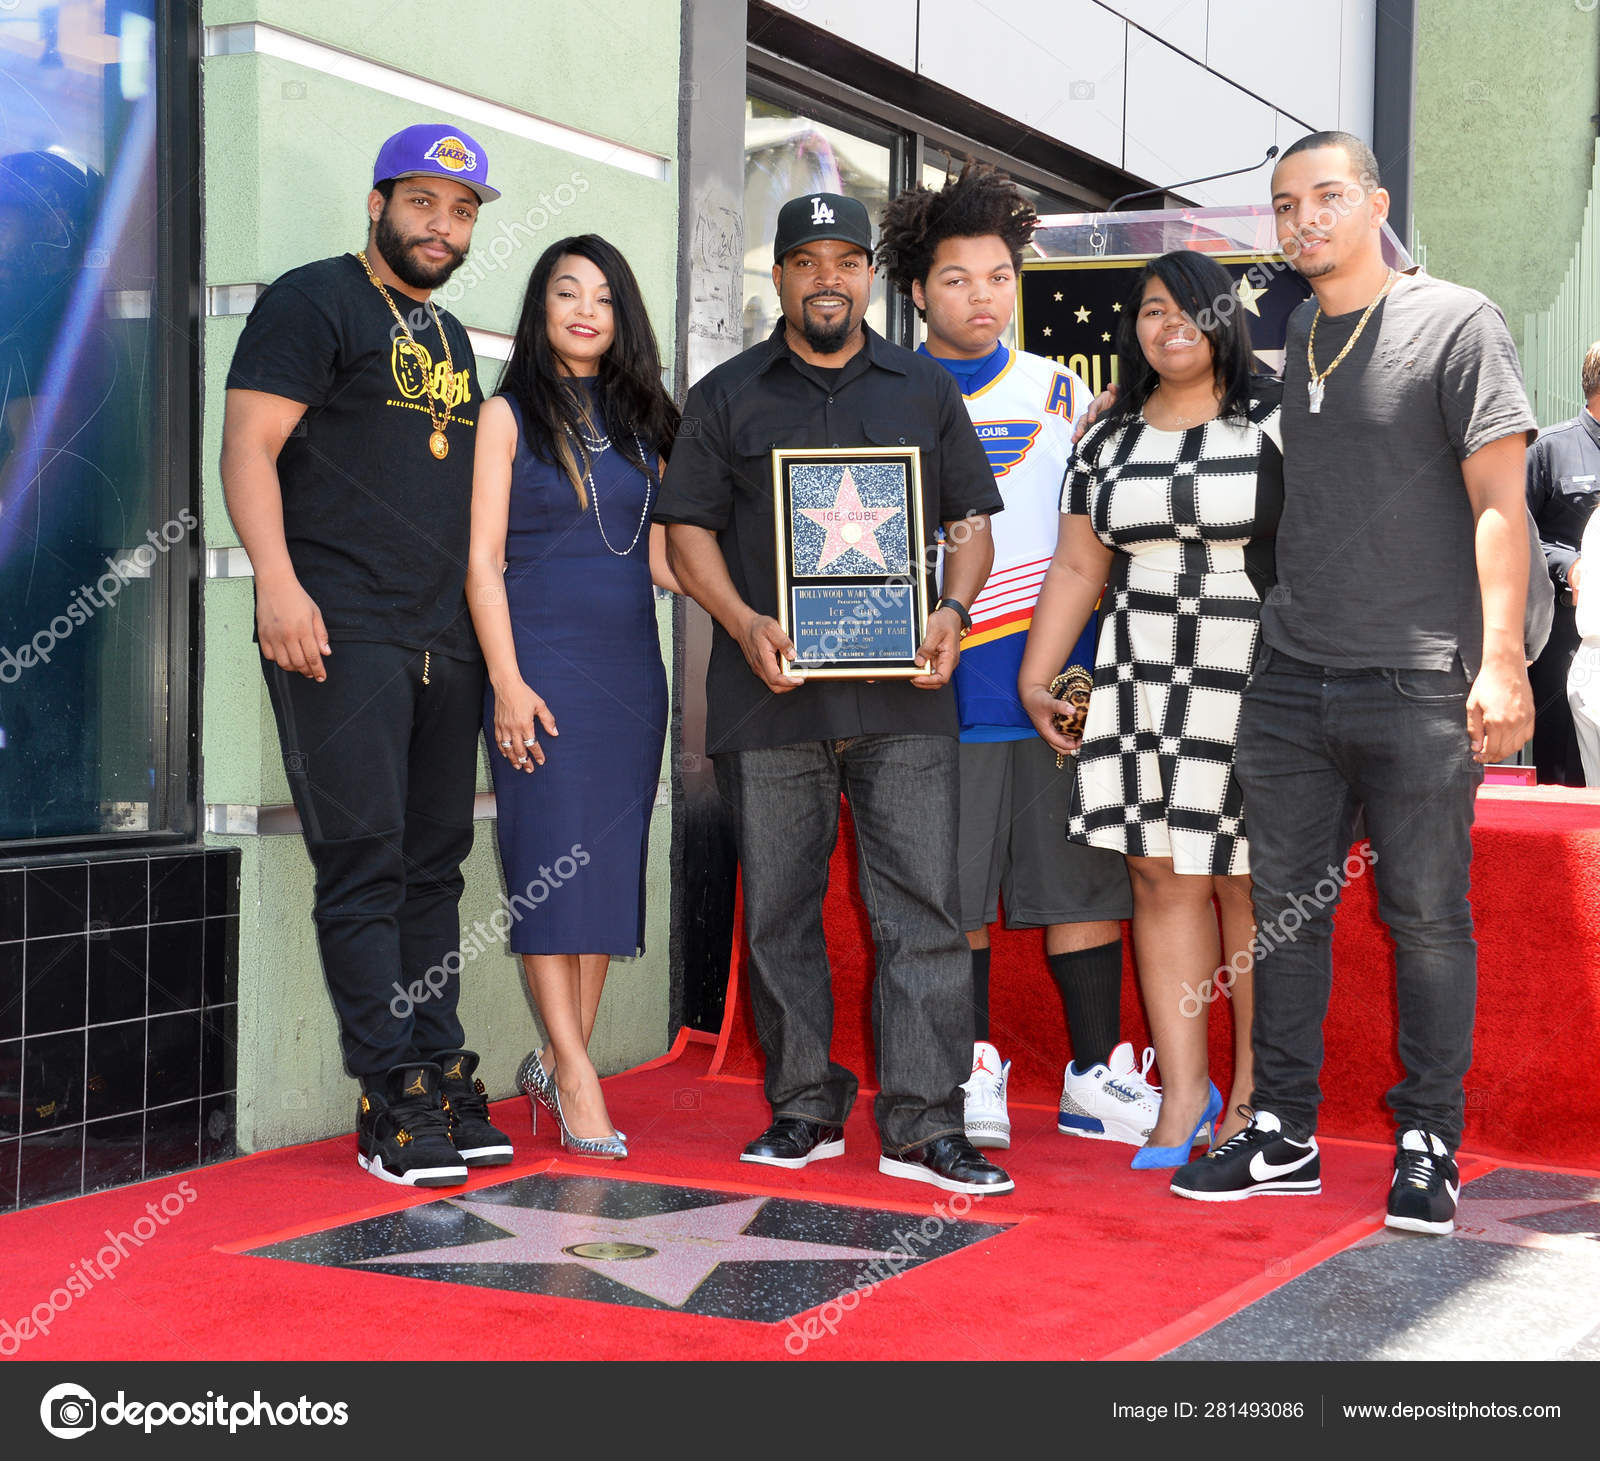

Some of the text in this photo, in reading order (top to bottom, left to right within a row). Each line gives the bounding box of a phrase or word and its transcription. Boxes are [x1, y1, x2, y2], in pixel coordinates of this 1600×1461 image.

[427, 141, 476, 170] LAKERS
[811, 197, 835, 225] LA
[1045, 370, 1074, 424] A
[386, 399, 434, 414] BILLIONAIR
[438, 411, 456, 421] BYS
[975, 426, 1009, 438] LOUIS
[823, 511, 878, 521] ICE CUBE
